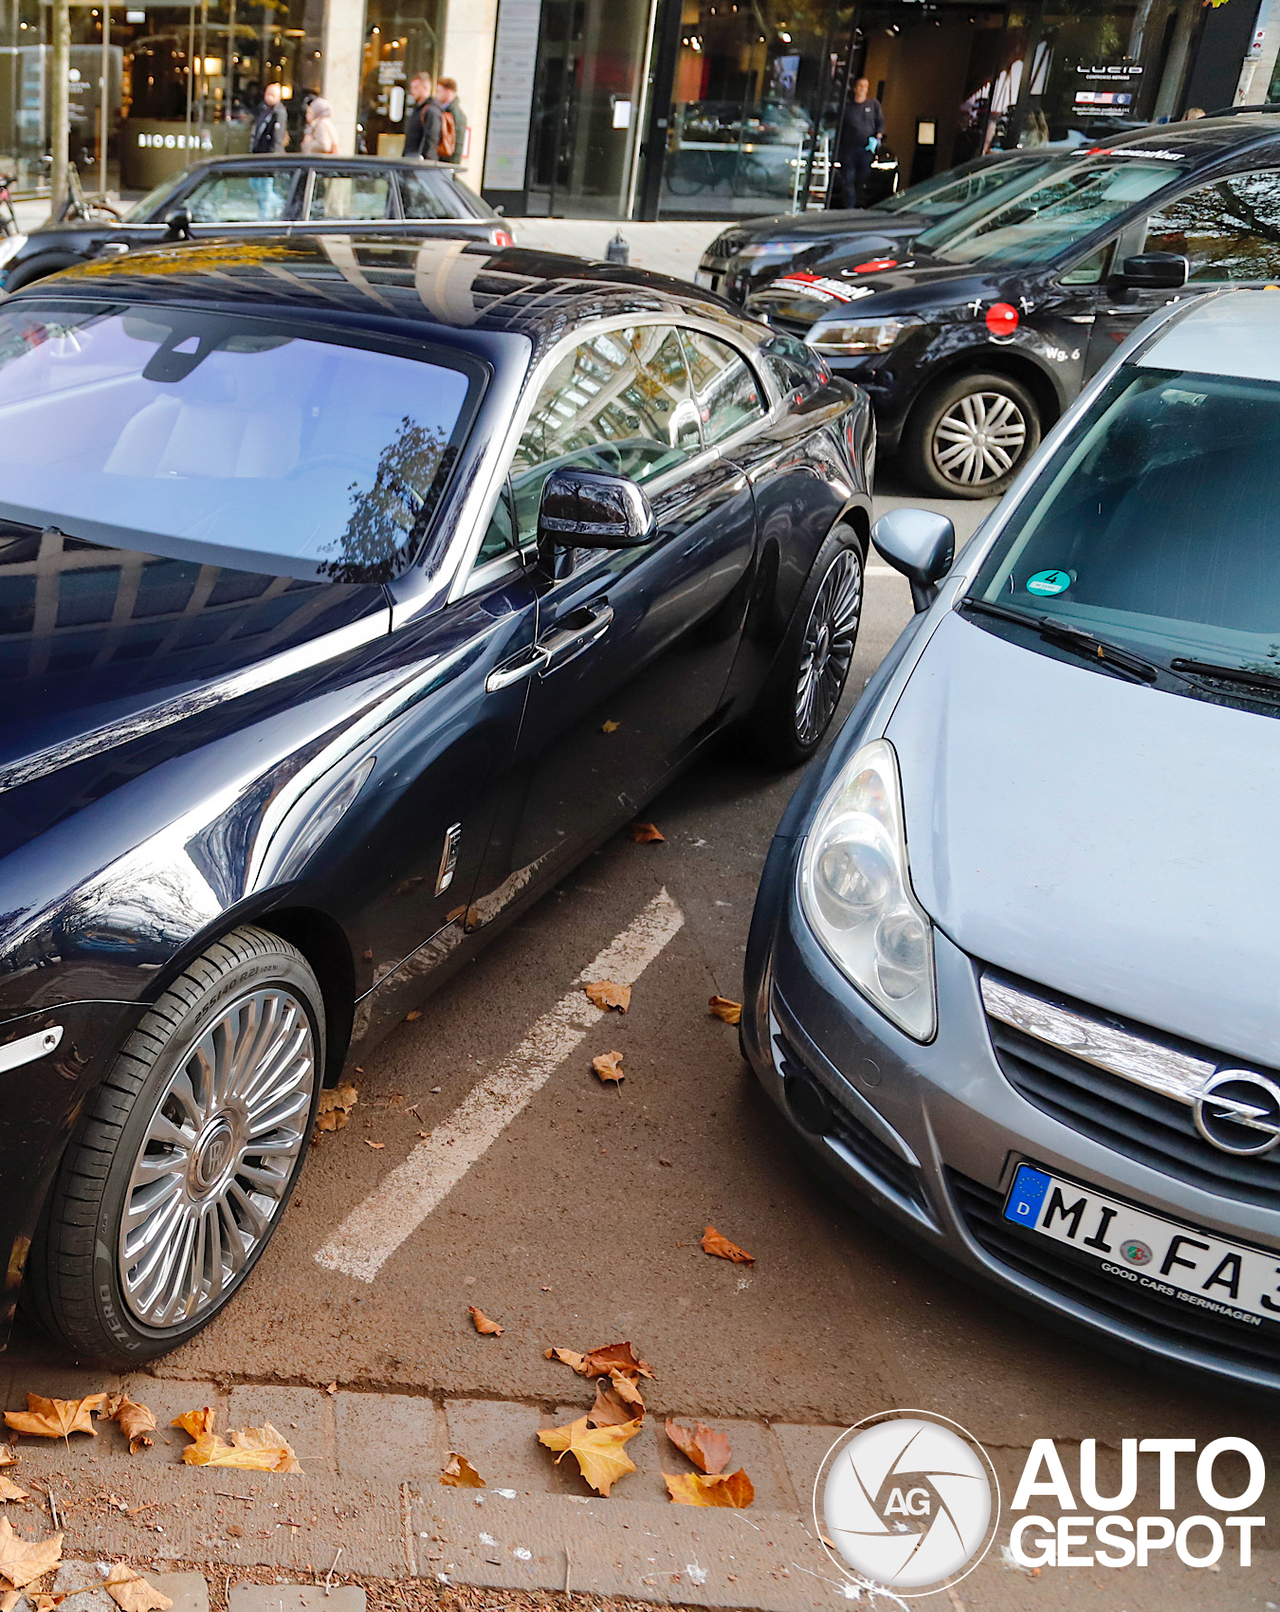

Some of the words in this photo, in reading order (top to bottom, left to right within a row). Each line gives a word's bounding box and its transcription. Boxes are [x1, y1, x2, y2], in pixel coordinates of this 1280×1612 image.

[1077, 65, 1143, 74] LUCID
[1046, 347, 1069, 362] Wg.
[1071, 348, 1081, 360] 6
[1044, 571, 1060, 584] 4
[1016, 1201, 1031, 1216] D
[1042, 1186, 1117, 1254] MI
[1159, 1234, 1242, 1299] FA
[1101, 1262, 1138, 1282] GOOD
[1140, 1277, 1175, 1297] CARS
[1176, 1291, 1262, 1326] ISERNHAGEN
